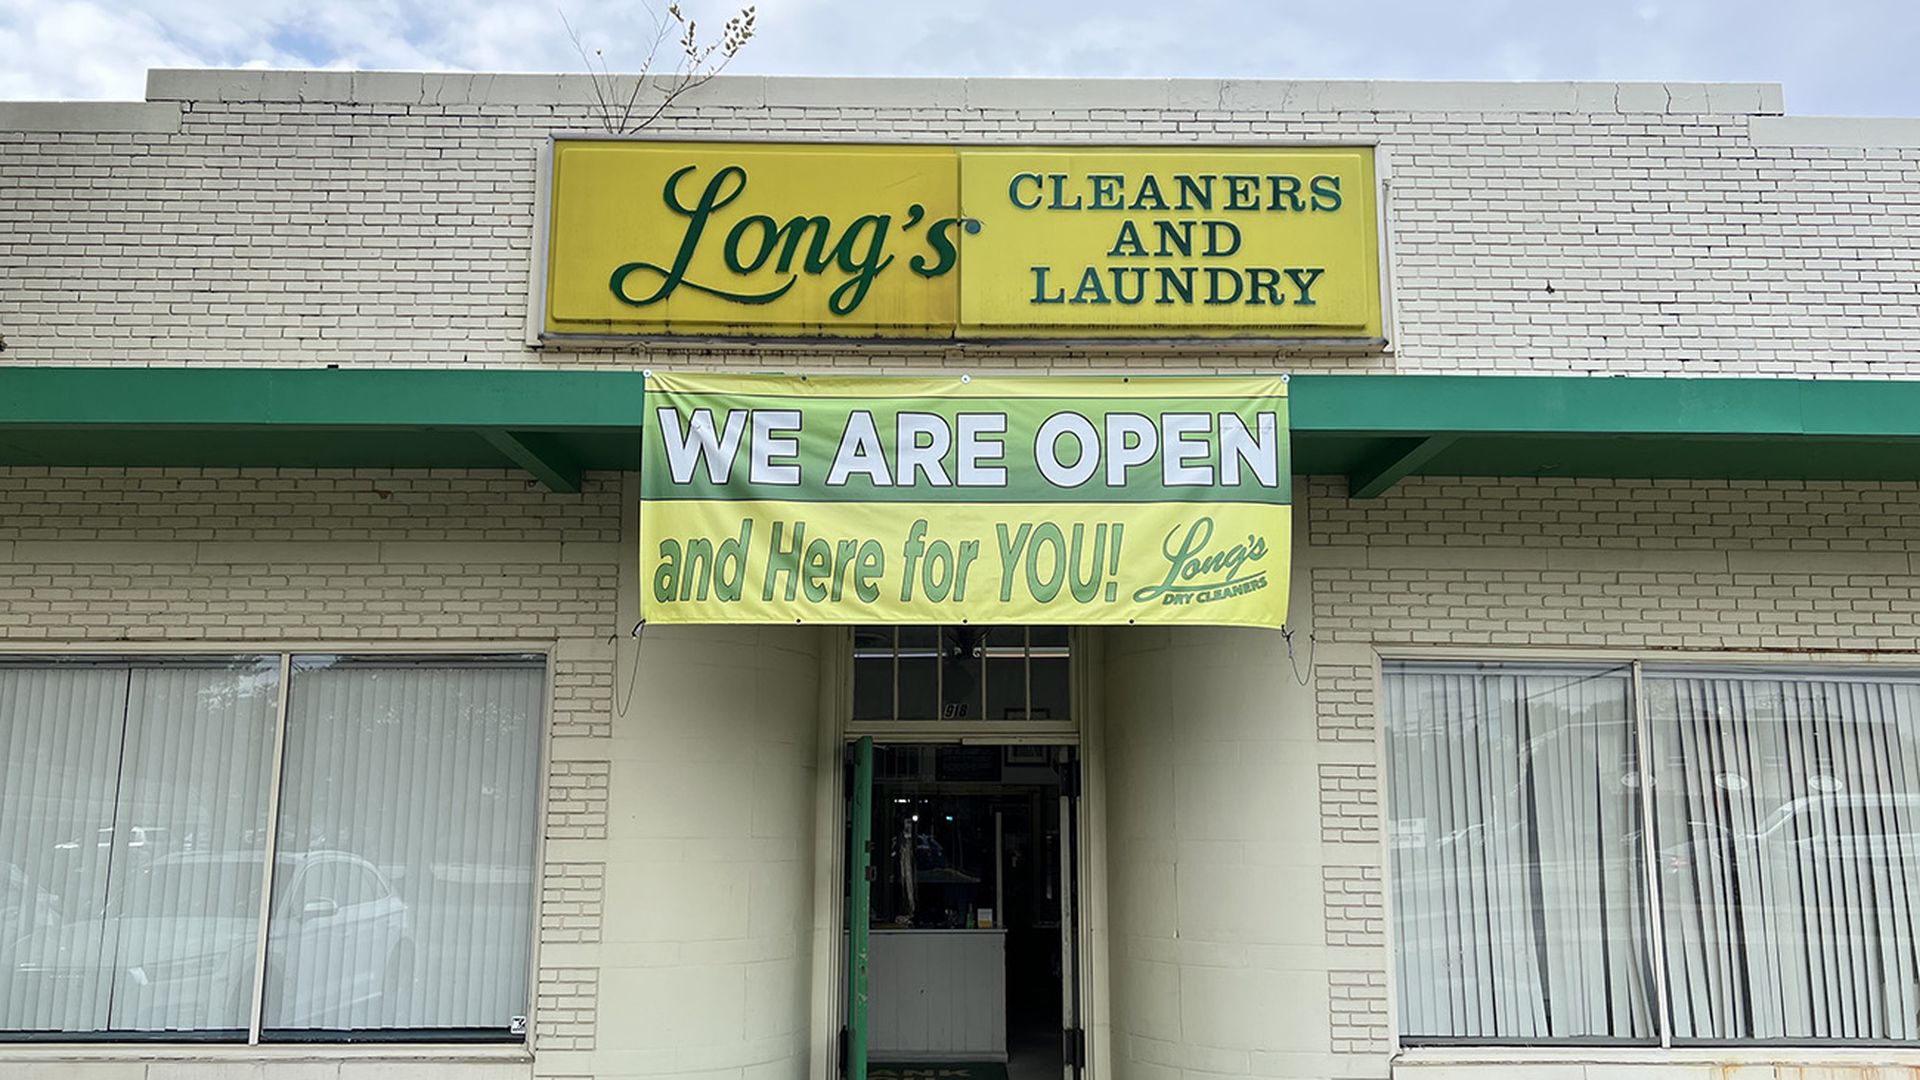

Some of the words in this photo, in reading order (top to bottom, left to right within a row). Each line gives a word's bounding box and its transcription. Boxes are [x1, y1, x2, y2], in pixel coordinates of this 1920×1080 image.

[1008, 172, 1343, 212] CLEANERS
[609, 165, 960, 315] Long's
[1107, 220, 1242, 257] AND
[1030, 266, 1325, 305] LAUNDRY
[656, 407, 802, 486] WE
[825, 409, 1008, 487] ARE
[1033, 410, 1279, 488] OPEN
[653, 518, 753, 603] and
[762, 521, 884, 603] Here
[900, 518, 980, 603] for
[995, 522, 1124, 604] YOU!
[1133, 516, 1269, 603] Long's
[1162, 592, 1194, 606] DRY
[1196, 576, 1268, 604] CLEANERS
[944, 703, 969, 718] 918
